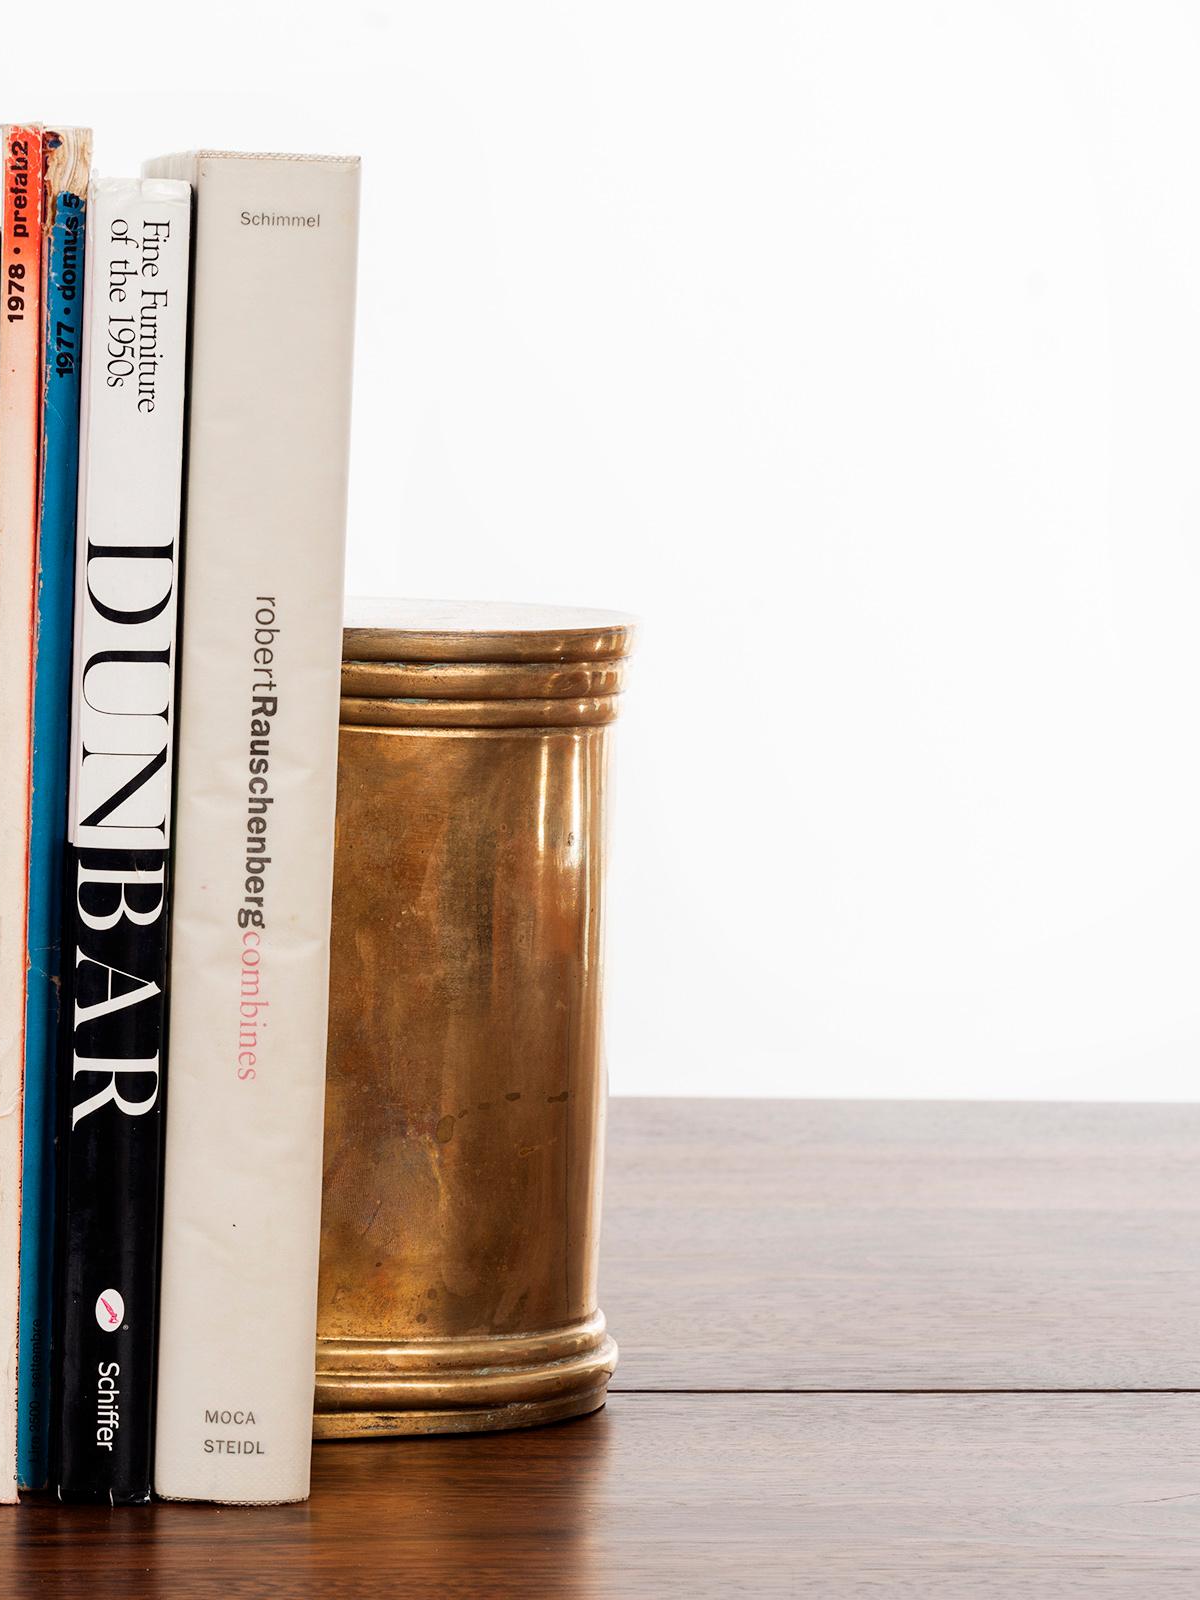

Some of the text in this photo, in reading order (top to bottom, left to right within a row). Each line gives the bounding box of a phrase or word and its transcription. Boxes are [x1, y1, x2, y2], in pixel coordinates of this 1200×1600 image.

[240, 212, 320, 228] Schimmel
[60, 216, 78, 300] domus
[8, 264, 26, 322] 1978
[106, 219, 138, 388] of the 1950s
[138, 220, 170, 414] Fine Furniture
[56, 322, 74, 378] 1977
[72, 537, 175, 1132] DUNBAR
[30, 1319, 42, 1388] settembre
[96, 1362, 120, 1452] Schiffer
[205, 1410, 256, 1424] MOCA
[204, 1440, 264, 1454] STEIDL
